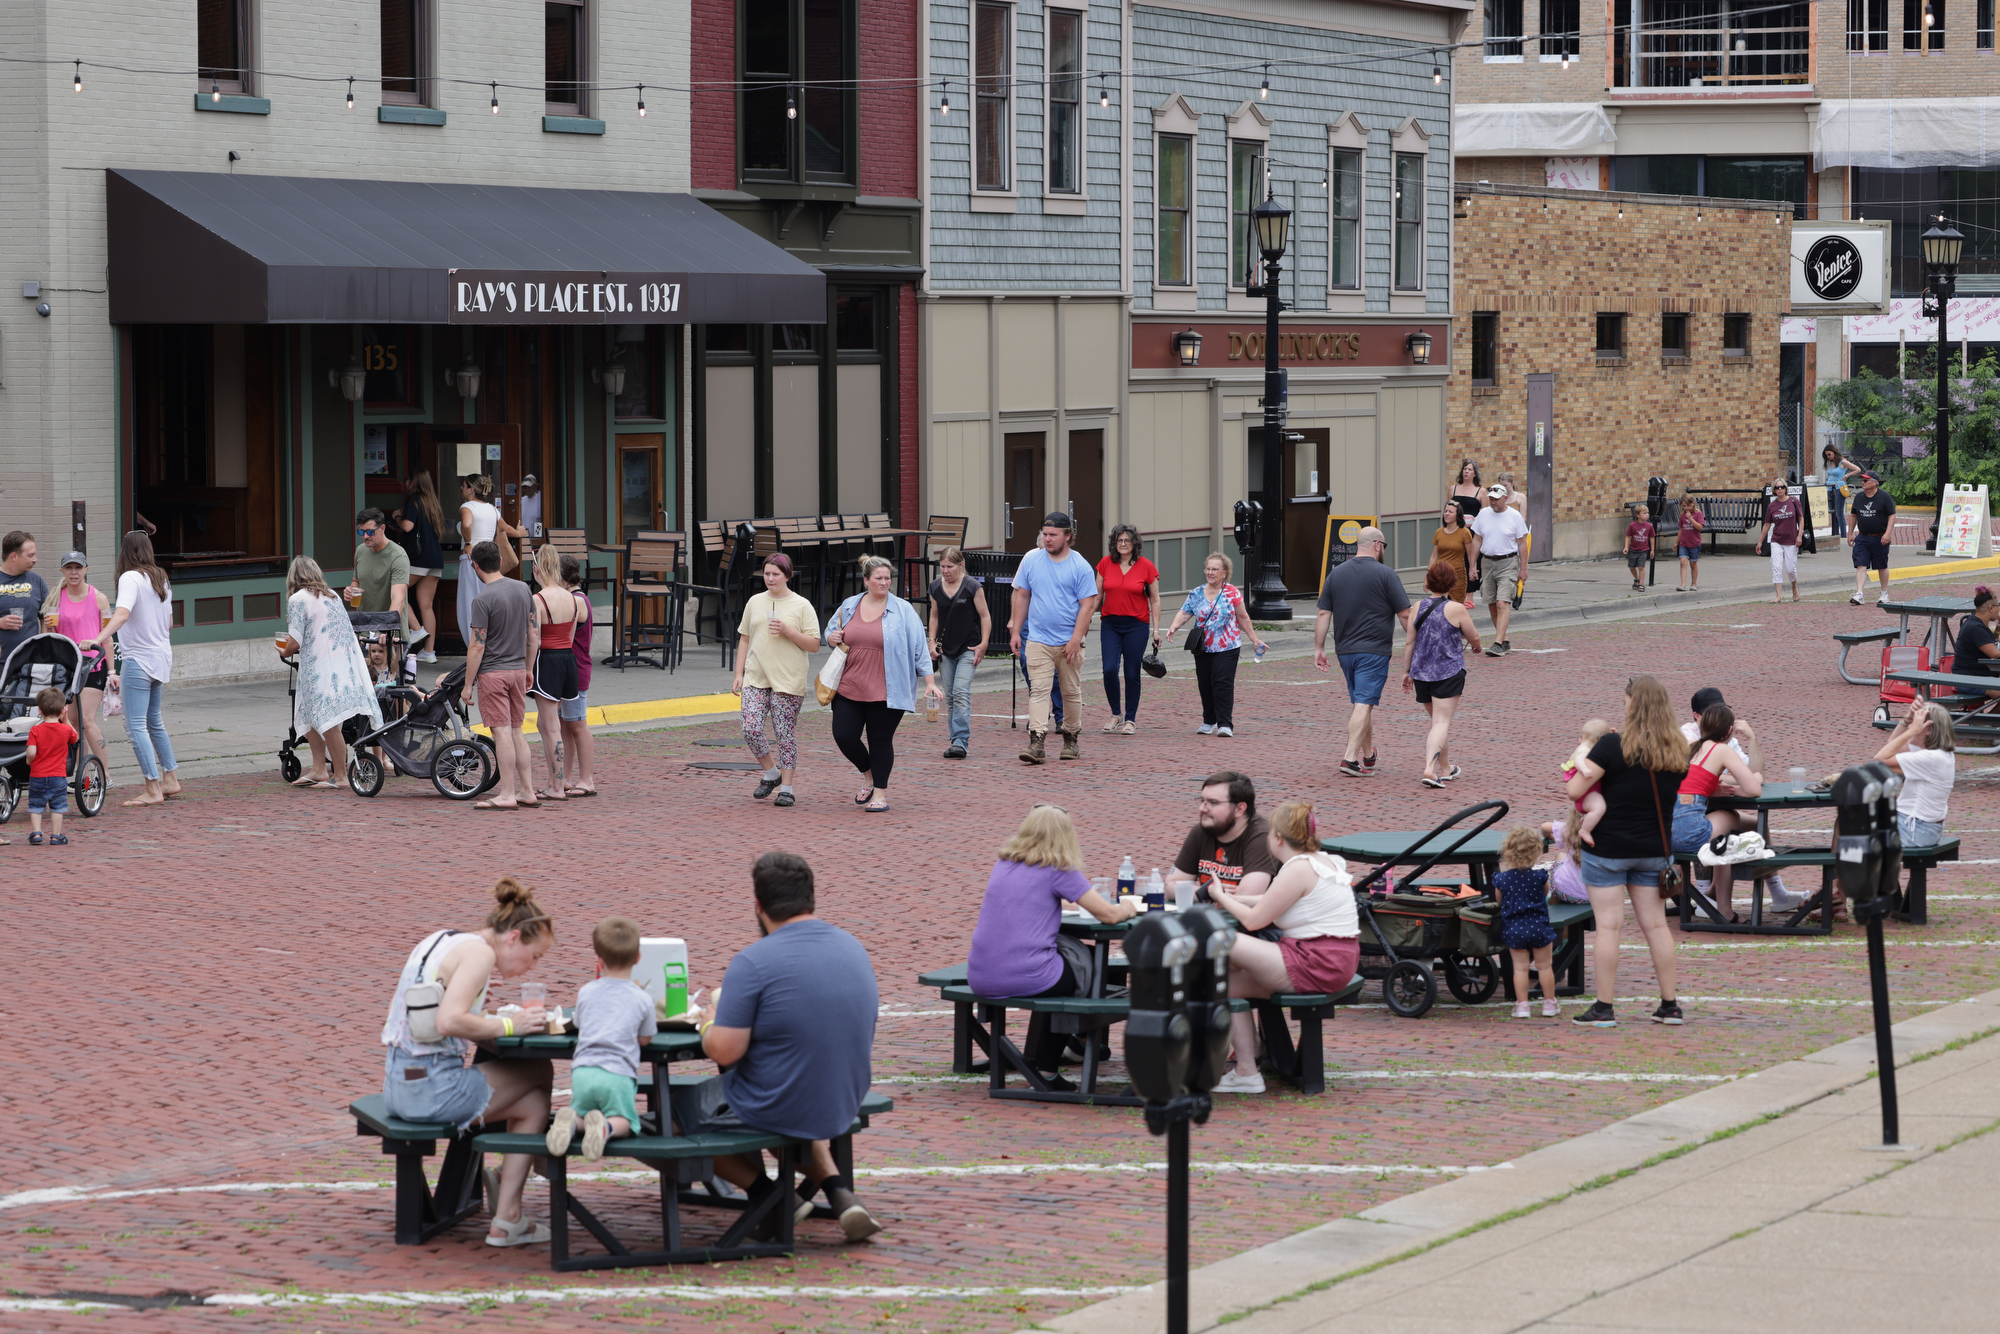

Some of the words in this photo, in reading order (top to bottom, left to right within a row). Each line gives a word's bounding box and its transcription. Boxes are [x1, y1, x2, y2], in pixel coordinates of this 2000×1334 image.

[1809, 248, 1856, 288] Venice
[457, 281, 517, 313] RAY'S
[523, 281, 589, 313] PLACE
[592, 282, 633, 313] EST.
[638, 282, 681, 313] 1937
[364, 344, 398, 371] 135
